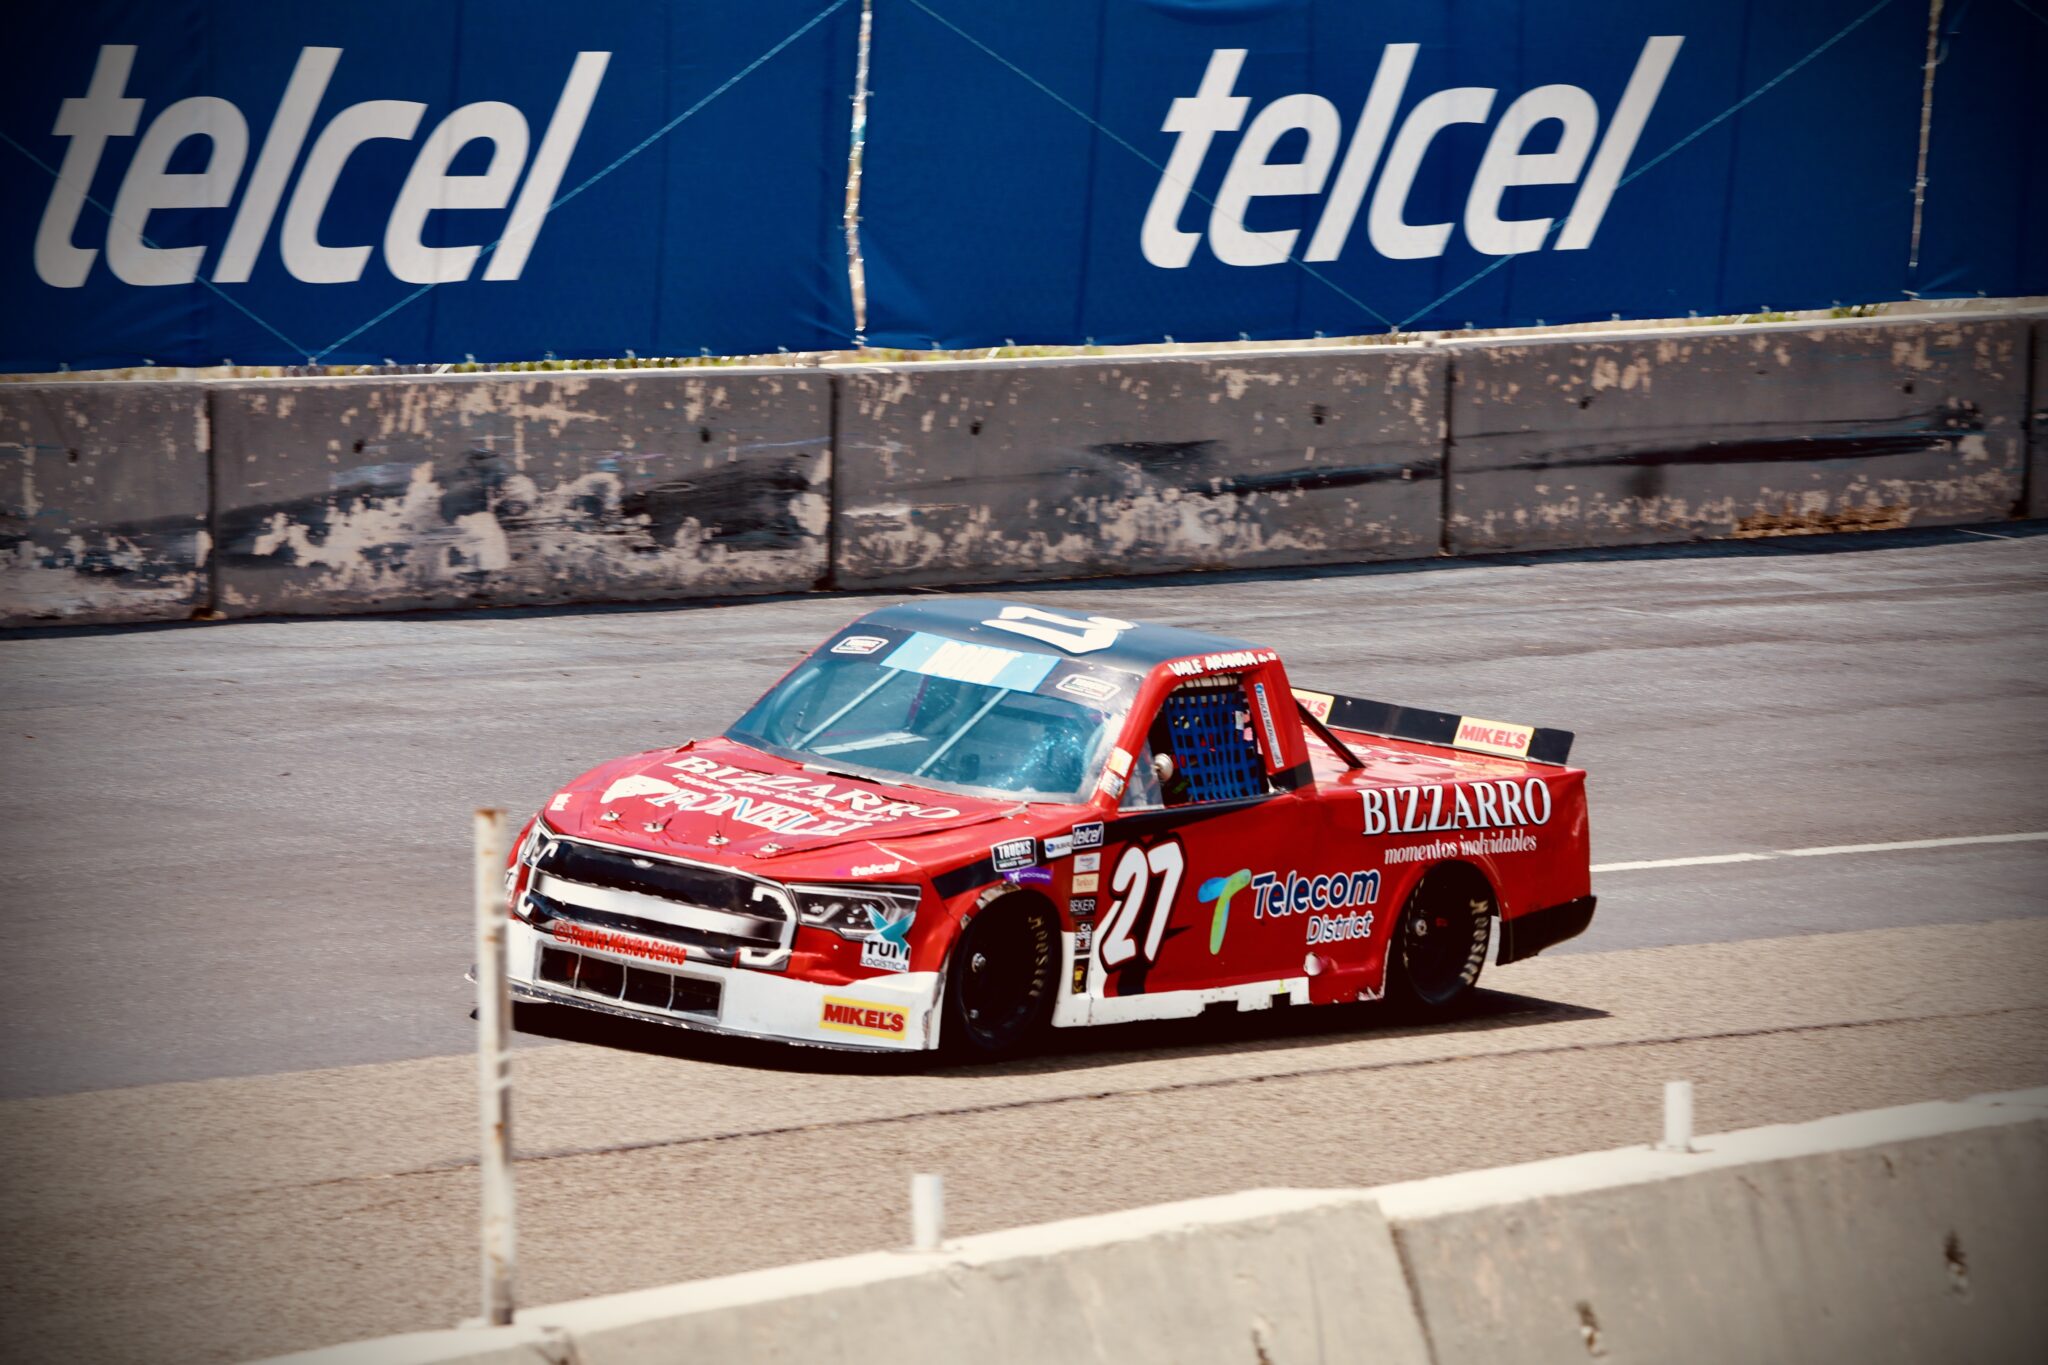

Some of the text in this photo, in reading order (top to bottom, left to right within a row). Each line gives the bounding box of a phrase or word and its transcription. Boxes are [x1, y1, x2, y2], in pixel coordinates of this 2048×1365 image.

[35, 45, 612, 288] telcel
[1141, 35, 1685, 268] telcel
[1459, 725, 1527, 749] MIKEL'S
[664, 756, 961, 818] BIZZARRO
[1357, 777, 1551, 836] BIZZARRO
[997, 841, 1032, 860] TRUCKS
[1384, 838, 1457, 864] momentos
[1101, 841, 1184, 967] 27
[1251, 869, 1380, 919] Telecom
[1306, 910, 1374, 945] District
[824, 1003, 904, 1032] MIKEL'S
